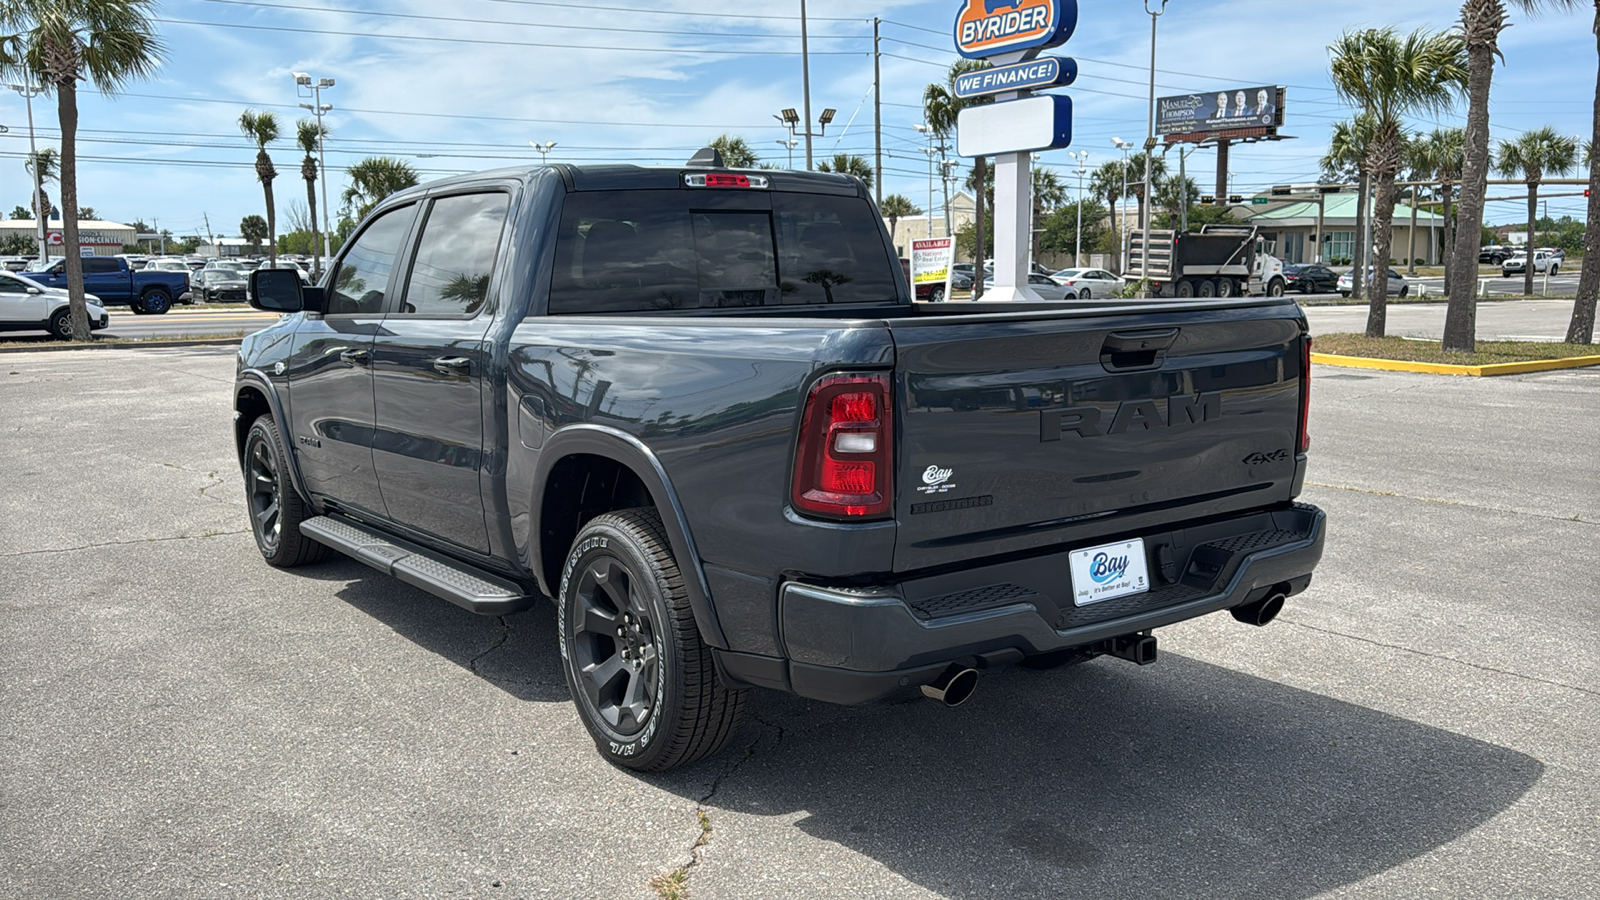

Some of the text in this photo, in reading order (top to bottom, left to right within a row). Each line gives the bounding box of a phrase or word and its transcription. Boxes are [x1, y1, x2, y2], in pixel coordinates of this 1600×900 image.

[961, 6, 1047, 43] BYRIDER
[960, 64, 1052, 91] WE FINANCE!
[914, 240, 950, 248] AVAILABLE
[1040, 392, 1222, 443] RAM
[922, 465, 953, 485] Bay
[1091, 552, 1130, 579] Bay
[558, 537, 610, 660] BRIDGESTONE
[1102, 584, 1116, 592] Better
[609, 741, 636, 756] H/L
